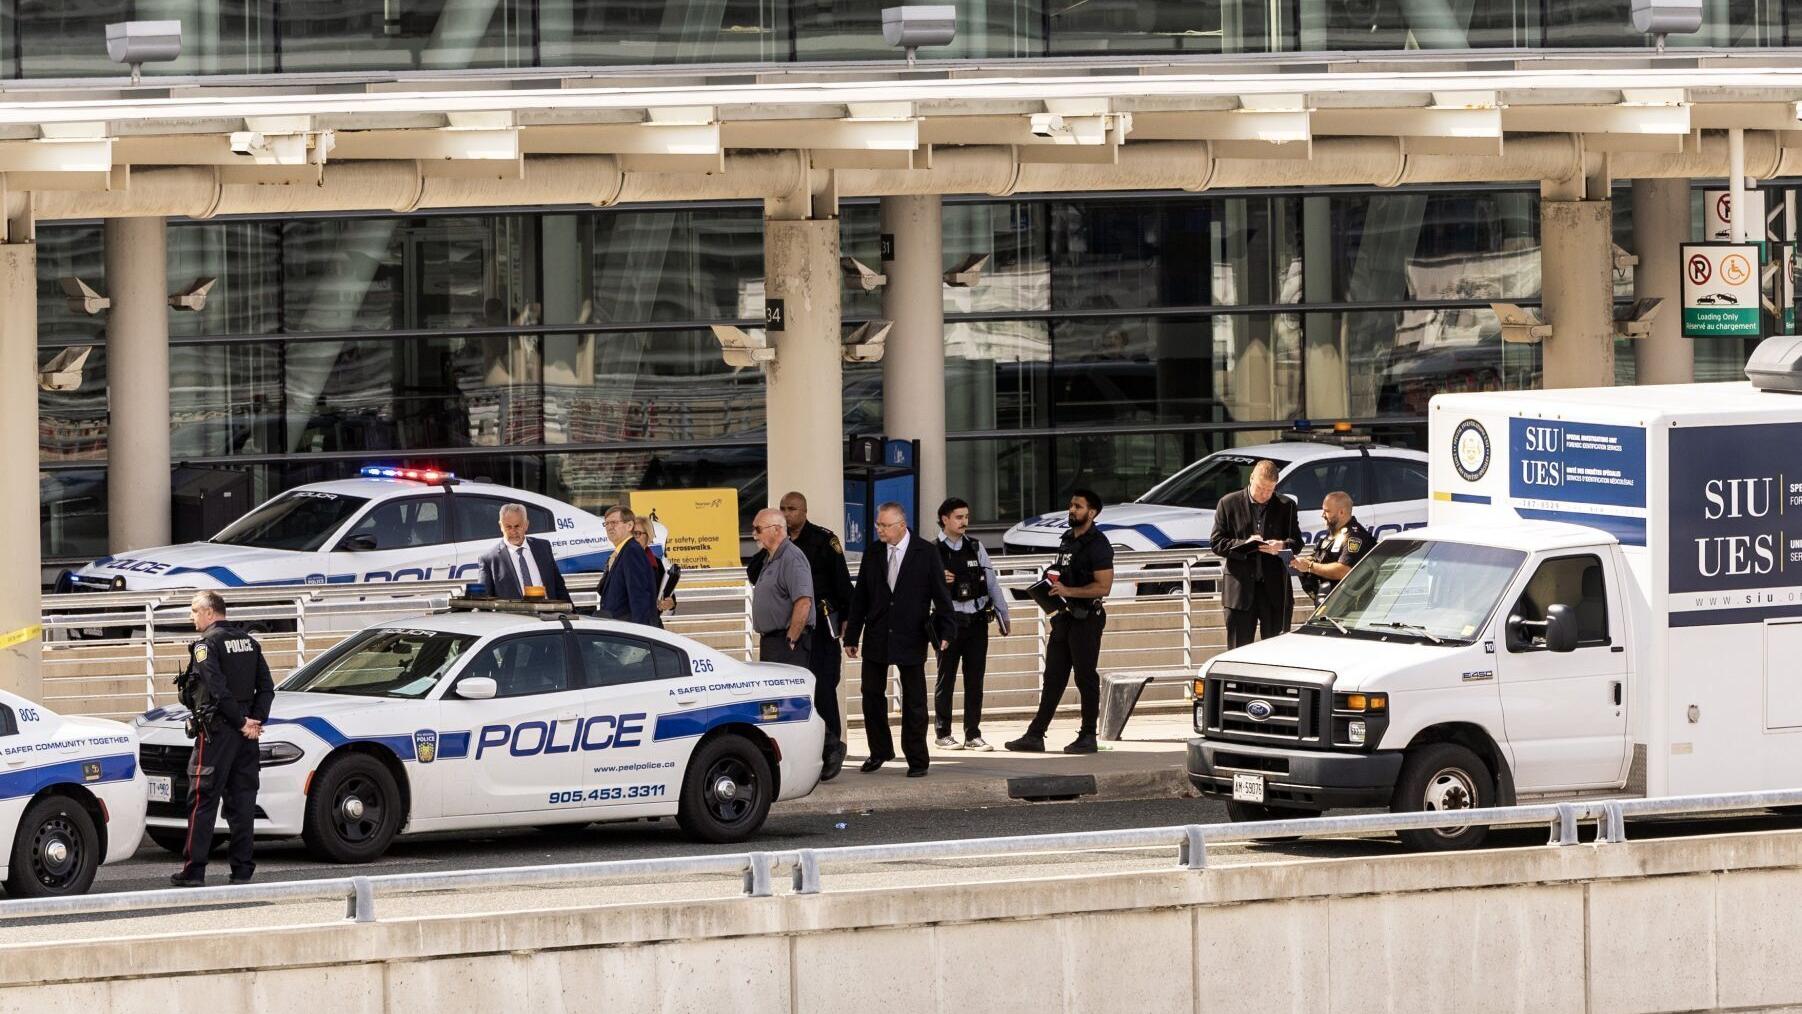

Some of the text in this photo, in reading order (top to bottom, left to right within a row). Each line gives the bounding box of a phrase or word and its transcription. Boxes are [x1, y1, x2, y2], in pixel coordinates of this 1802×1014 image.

[767, 307, 781, 322] 34
[1697, 312, 1739, 323] Loading Only
[1716, 322, 1757, 331] chargement
[1526, 426, 1559, 452] SIU
[1521, 459, 1560, 486] UES
[1705, 477, 1773, 520] SIU
[556, 518, 575, 530] 945
[569, 536, 608, 546] COMMUNI
[672, 544, 713, 552] crosswalks.
[674, 536, 698, 545] safety,
[698, 536, 720, 544] please
[1694, 534, 1774, 577] UES
[224, 639, 254, 654] POLICE
[1485, 643, 1494, 651] 10
[692, 658, 714, 673] 256
[669, 678, 806, 697] A SAFER COMMUNITY TOGETHER
[18, 708, 40, 722] 805
[475, 712, 648, 761] POLICE
[5, 745, 34, 756] SAFER
[35, 739, 87, 752] COMMUNITY
[88, 735, 130, 746] TOGETHER
[593, 761, 676, 773] www.peelpolice.ca
[548, 784, 667, 804] 905.453.3311
